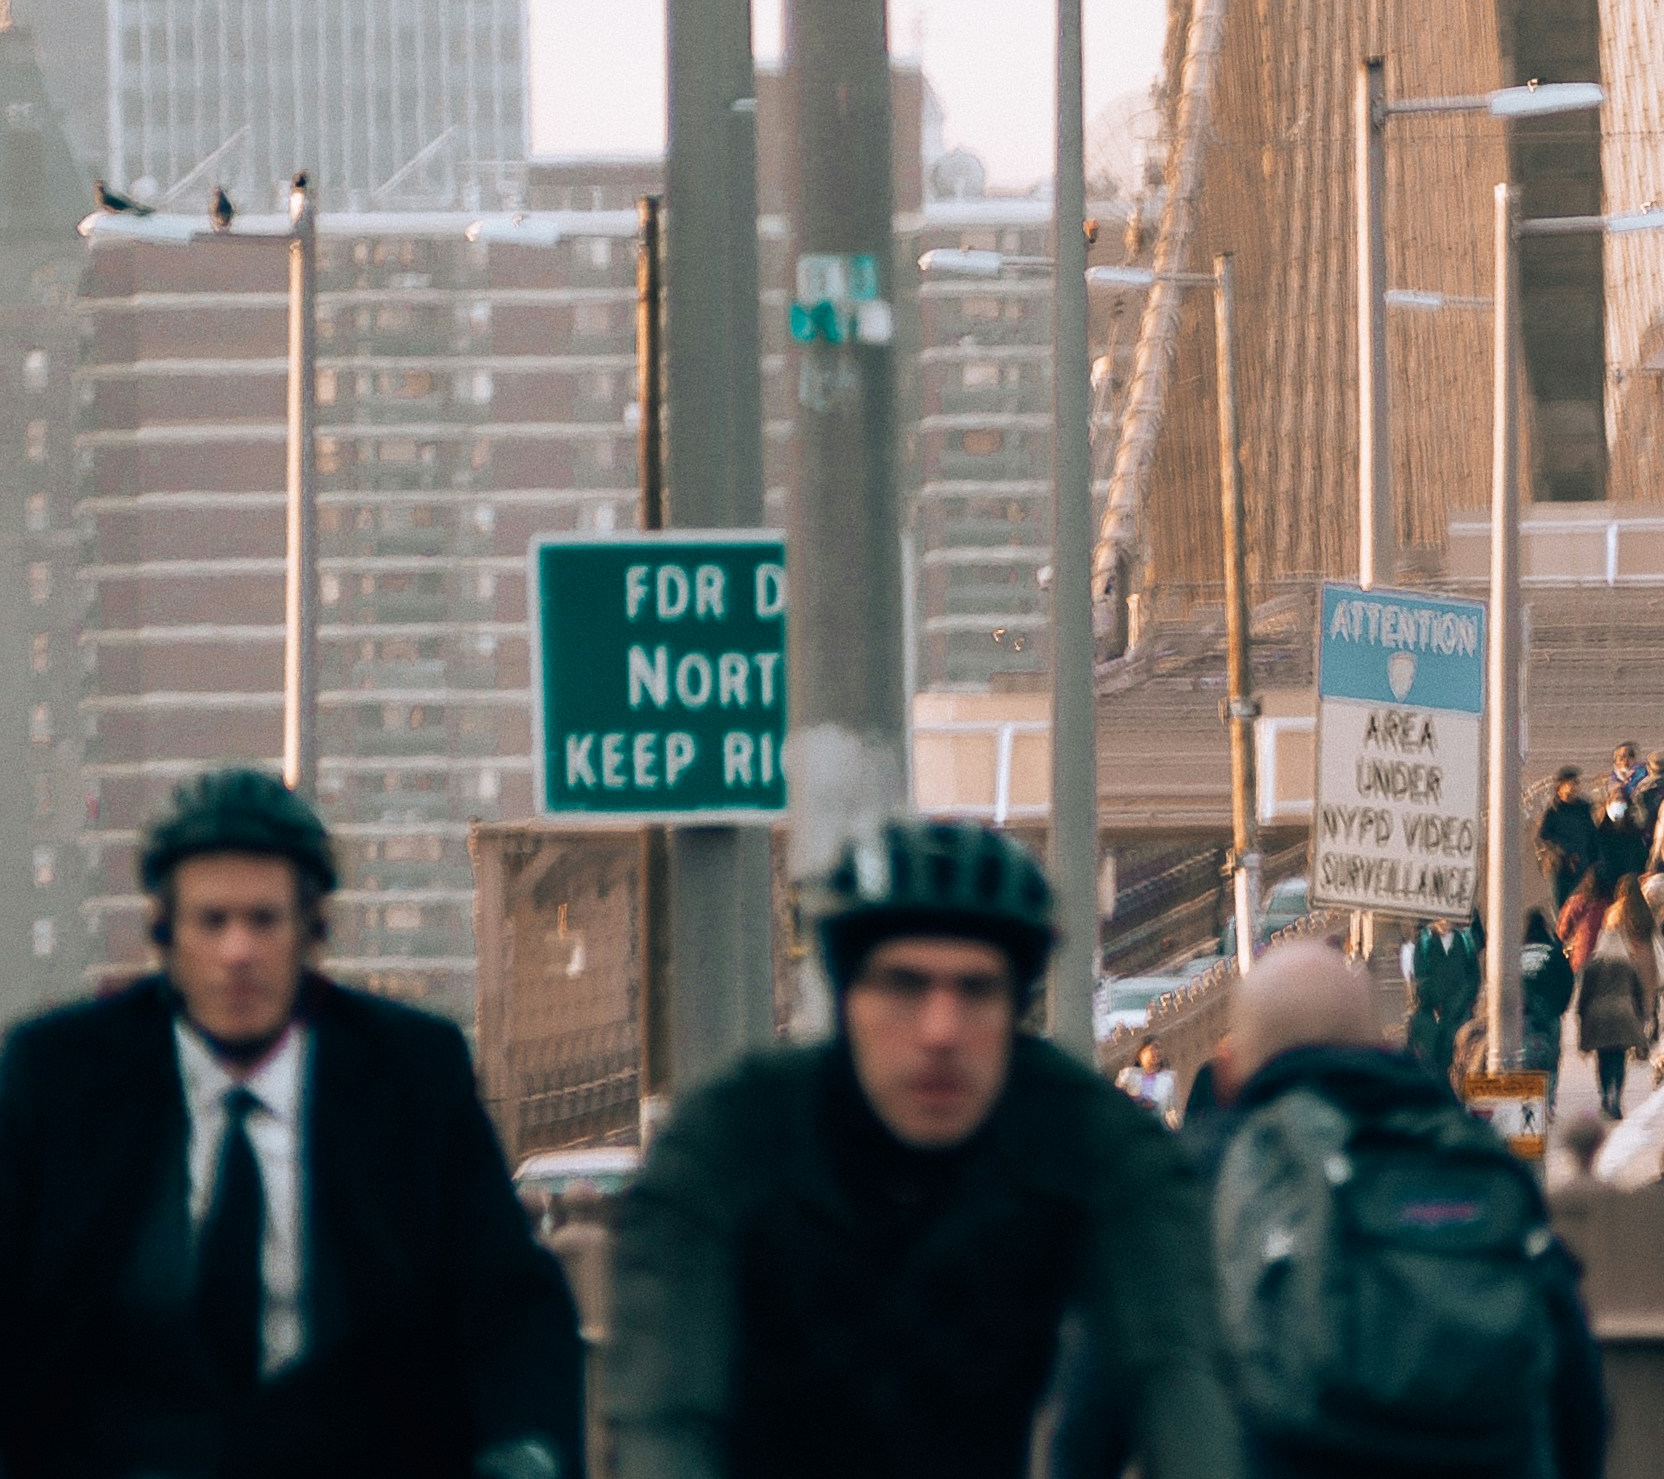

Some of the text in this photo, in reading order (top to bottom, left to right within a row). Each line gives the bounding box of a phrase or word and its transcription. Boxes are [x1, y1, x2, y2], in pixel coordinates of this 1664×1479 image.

[624, 563, 786, 620] FDR D
[1330, 599, 1478, 657] ATTENTION
[627, 644, 782, 710] NORT
[565, 731, 785, 789] KEEP RI
[1364, 709, 1438, 756] AREA
[1356, 756, 1443, 805] UNDER
[1321, 804, 1474, 858] NYPD VIDEO
[1321, 852, 1473, 908] SURVEILLANCE
